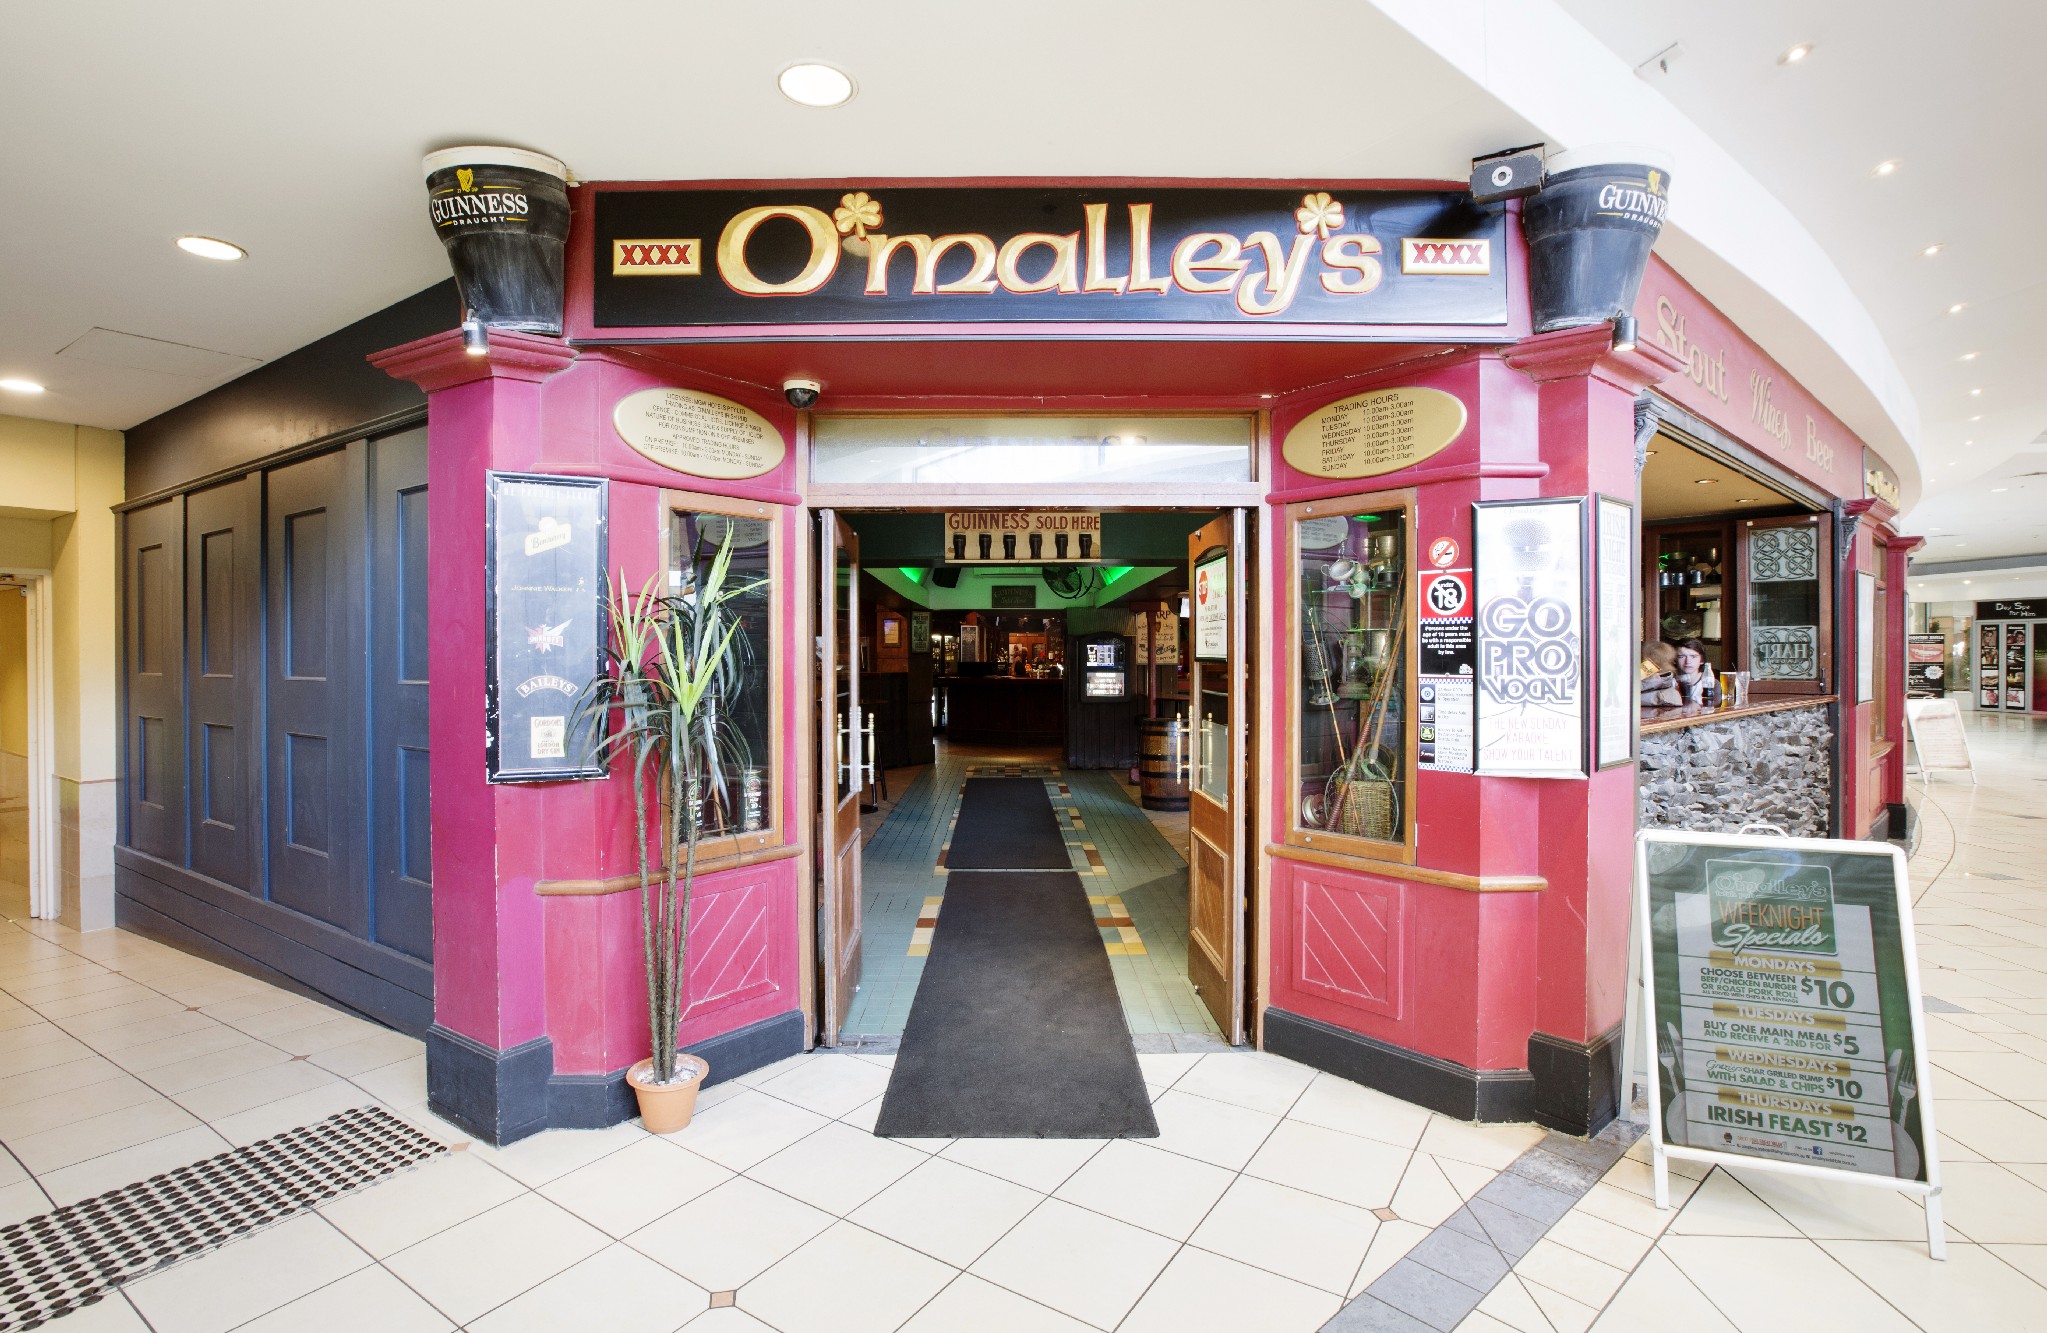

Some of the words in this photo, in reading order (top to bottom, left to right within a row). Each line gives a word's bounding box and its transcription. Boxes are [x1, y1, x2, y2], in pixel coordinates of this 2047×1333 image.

[432, 193, 529, 223] GUINNESS
[452, 216, 506, 226] DRAUGHT
[619, 244, 691, 266] XXXX
[1412, 243, 1484, 265] XXXX
[1656, 295, 1729, 403] Stout
[1334, 399, 1368, 413] TRADING
[1370, 393, 1398, 405] HOURS
[1321, 413, 1347, 423] MONDAY
[1321, 421, 1350, 432] TUESDAY
[1321, 426, 1361, 440] WEDNESDAY
[1321, 436, 1355, 448] THURSDAY
[1321, 446, 1343, 456] FRIDAY
[1805, 415, 1835, 475] Beer
[1321, 452, 1354, 464] SATURDAY
[1321, 461, 1347, 472] SUNDAY
[948, 513, 1030, 530] GUINNESS
[1036, 516, 1069, 530] SOLD
[1071, 516, 1100, 531] HERE
[1434, 587, 1459, 609] 18
[1485, 597, 1573, 638] GO
[1484, 640, 1573, 676] PRO
[521, 676, 573, 694] BAILEYS
[1508, 717, 1528, 730] NEW
[1530, 717, 1567, 730] SUNDAY
[1506, 732, 1549, 745] KARAOKE
[1483, 748, 1508, 761] SHOW
[1511, 748, 1535, 761] YOUR
[1537, 748, 1573, 763] TALENT
[1719, 901, 1824, 931] WEEKNIGHT
[1716, 924, 1829, 956] Specials
[1734, 956, 1816, 973] MONDAYS
[1700, 967, 1744, 979] CHOOSE
[1746, 971, 1796, 984] BETWEEN
[1700, 975, 1761, 987] BEEF/CHICKEN
[1762, 981, 1797, 992] BURGER
[1716, 983, 1745, 994] ROAST
[1747, 987, 1773, 997] PORK
[1775, 990, 1799, 999] ROLL
[1801, 976, 1855, 1009] $10
[1736, 1005, 1816, 1025] TUESDAYS
[1703, 1020, 1727, 1030] BUY
[1730, 1023, 1756, 1034] ONE
[1760, 1026, 1794, 1038] MAIN
[1797, 1031, 1831, 1043] MEAL
[1704, 1029, 1727, 1038] AND
[1730, 1032, 1769, 1044] RECEIVE
[1772, 1035, 1780, 1045] A
[1784, 1038, 1806, 1048] 2ND
[1810, 1041, 1831, 1051] FOR
[1833, 1032, 1860, 1055] $5
[1727, 1049, 1838, 1073] WEDNESDAYS
[1707, 1069, 1737, 1082] WITH
[1740, 1074, 1775, 1087] SALAD
[1779, 1080, 1788, 1089] &
[1791, 1081, 1825, 1094] CHIPS
[1743, 1067, 1765, 1076] CHAR
[1766, 1069, 1797, 1079] GRILLED
[1798, 1073, 1823, 1083] RUMP
[1826, 1076, 1863, 1100] $10
[1738, 1091, 1833, 1116] THURSDAYS
[1707, 1104, 1764, 1128] IRISH
[1768, 1113, 1833, 1138] FEAST
[1836, 1122, 1868, 1144] $12
